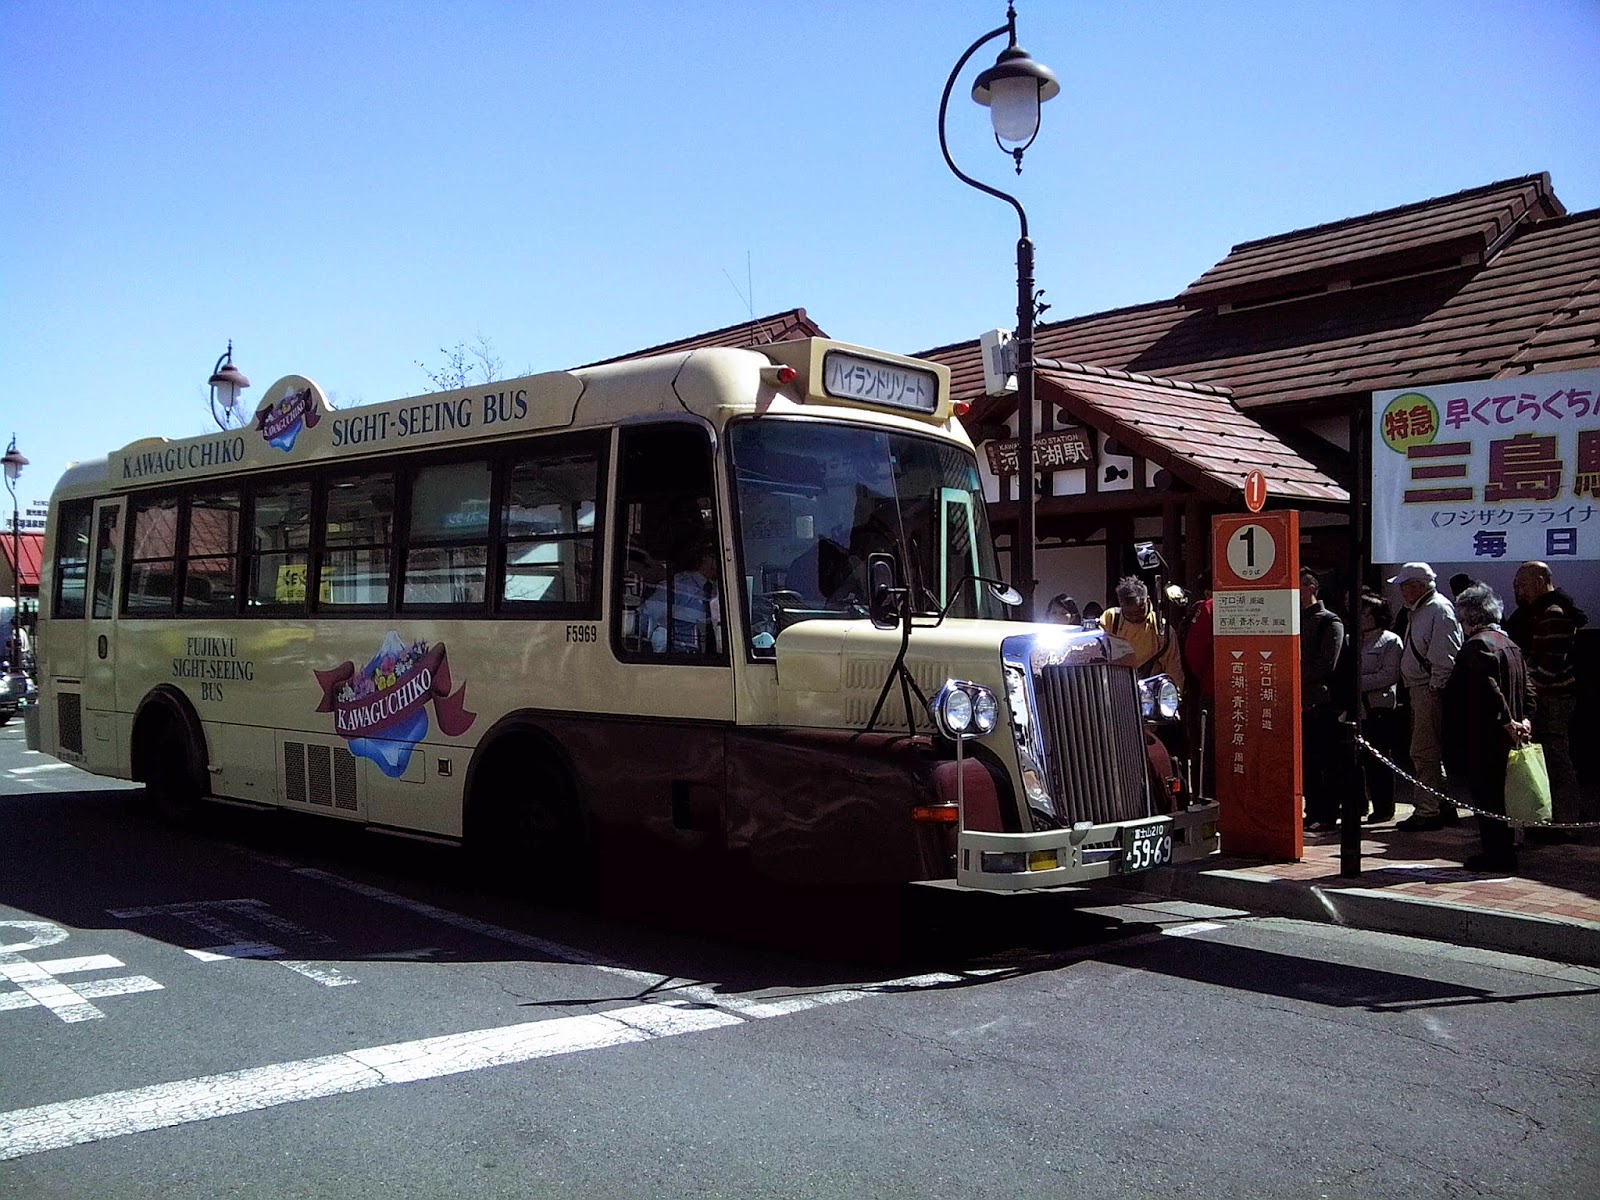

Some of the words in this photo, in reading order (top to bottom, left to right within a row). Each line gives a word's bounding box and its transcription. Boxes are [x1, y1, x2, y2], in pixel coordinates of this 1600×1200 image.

[331, 398, 472, 447] SIGHT-SEEING
[483, 389, 528, 425] BUS
[1384, 404, 1434, 441] 特急
[1048, 432, 1079, 445] STATION
[122, 437, 245, 479] KAWAGUCHIKO
[1251, 472, 1259, 502] 1
[1239, 527, 1255, 567] 1
[187, 636, 238, 658] FUJIKYU
[565, 624, 598, 643] F5969
[172, 658, 254, 682] SIGHT-SEEING
[1259, 662, 1273, 701] 河口湖
[201, 682, 224, 702] BUS
[337, 667, 432, 731] KAWAGUCHIKO
[1132, 836, 1172, 869] 59-69
